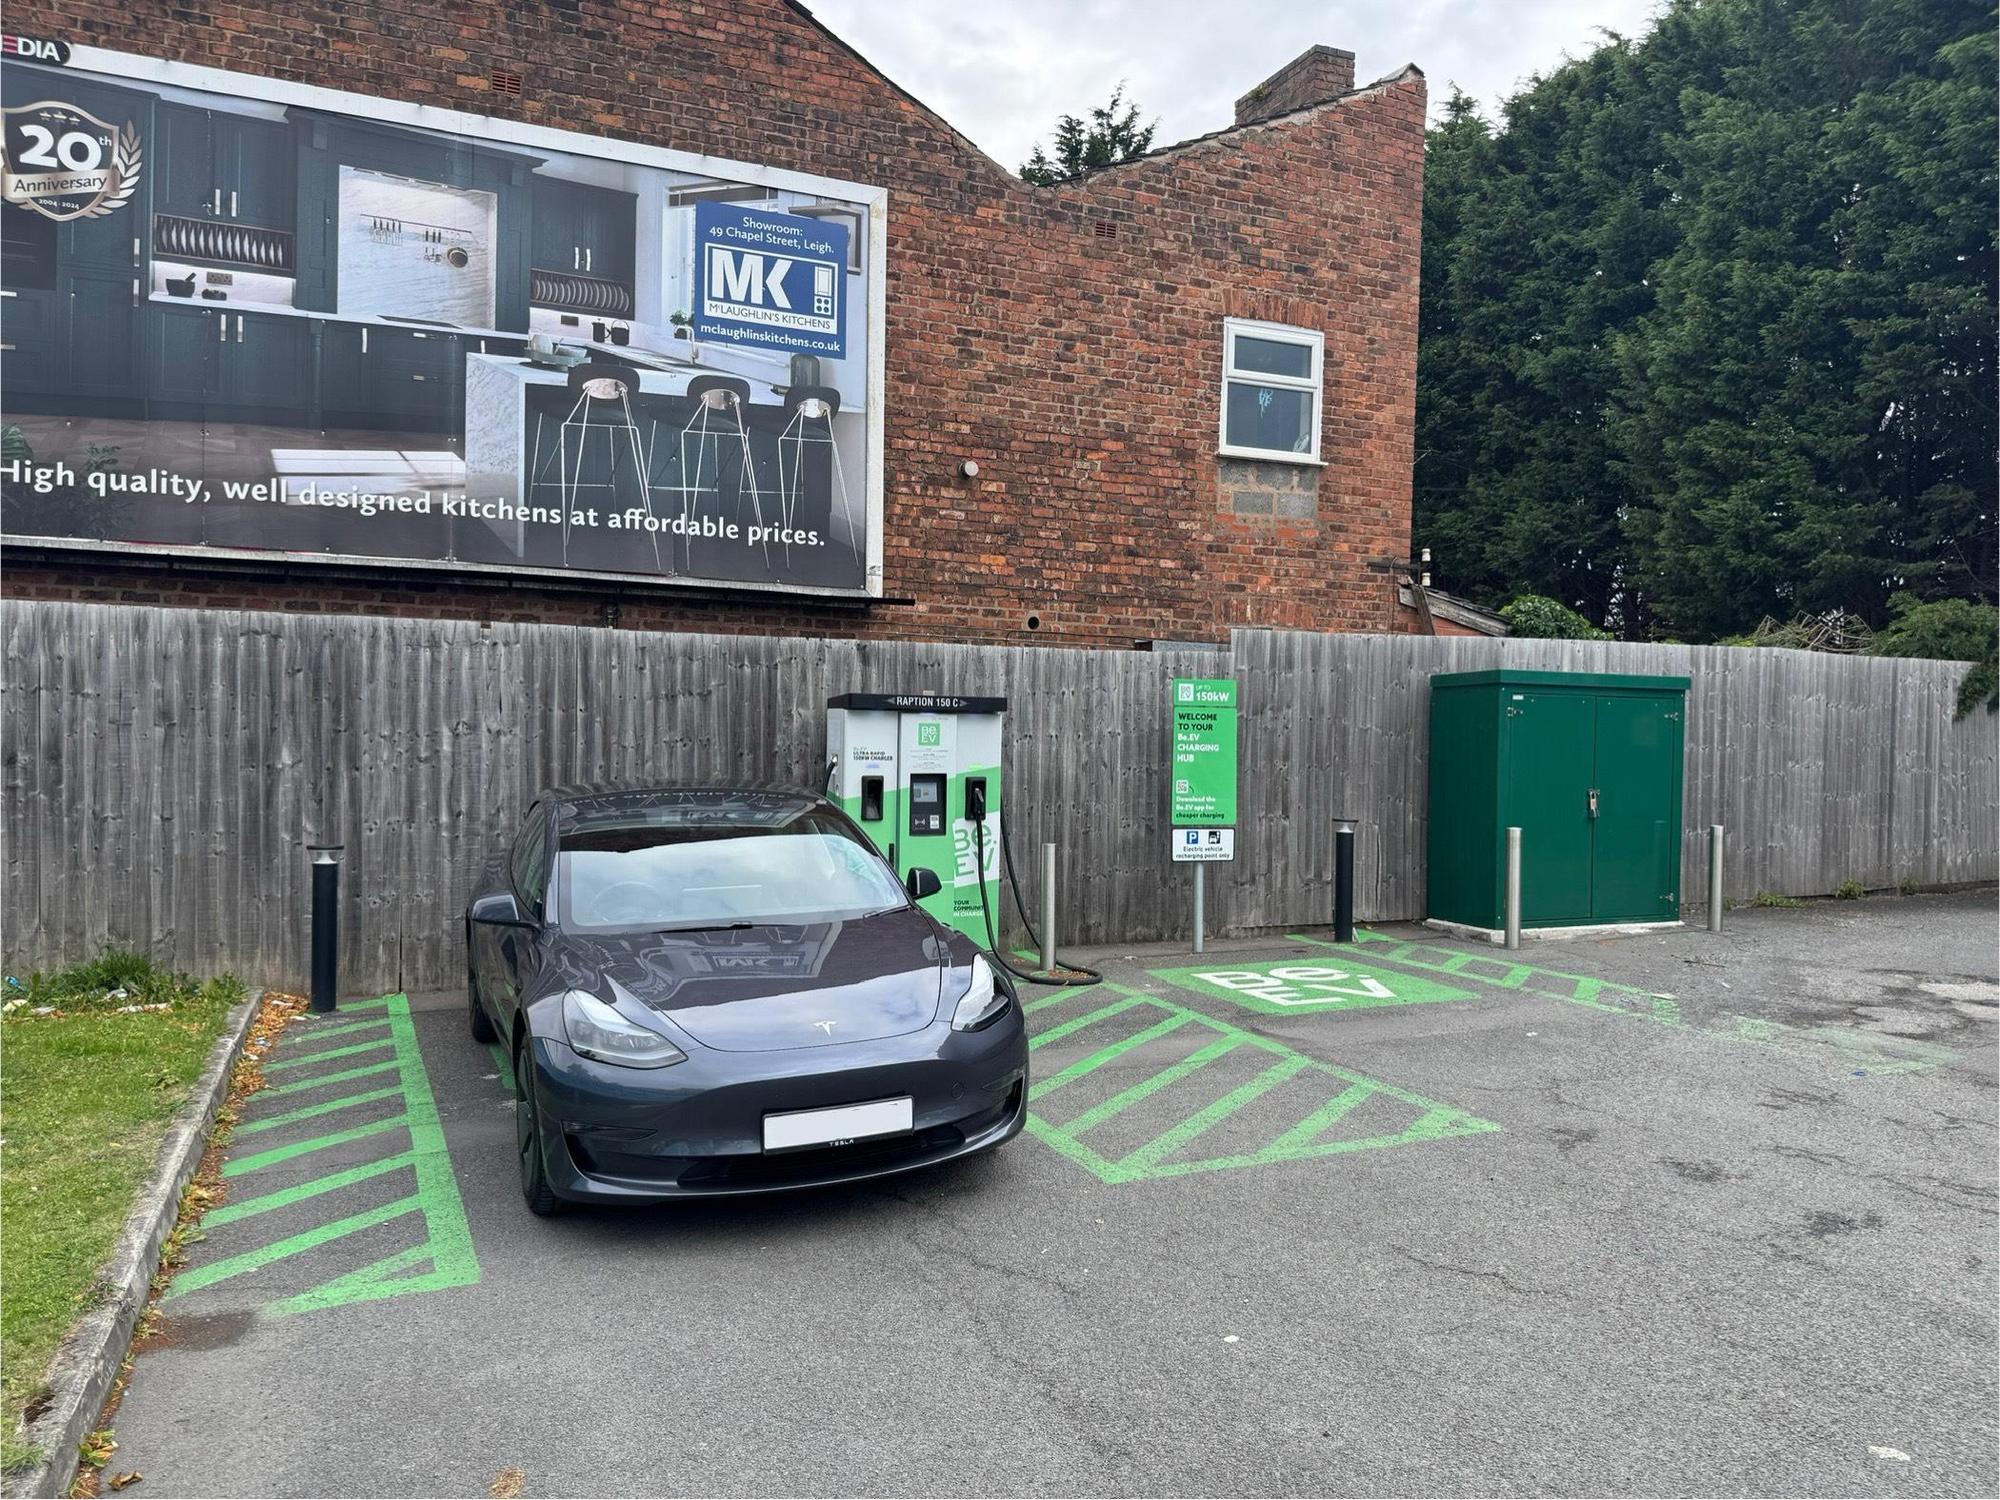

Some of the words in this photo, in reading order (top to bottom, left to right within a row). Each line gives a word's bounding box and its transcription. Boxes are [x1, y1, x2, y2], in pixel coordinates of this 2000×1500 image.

[13, 175, 107, 193] Anniversary
[38, 199, 57, 207] 2004
[62, 202, 80, 210] 2024
[743, 217, 803, 236] Showroom:
[709, 226, 723, 237] 49
[726, 227, 763, 242] Chapel
[766, 234, 801, 249] Street,
[804, 240, 834, 255] Leigh.
[711, 248, 793, 309] MK
[782, 310, 831, 330] KITCHENS
[700, 324, 841, 352] mclaughlinskitchens.co.uk
[88, 469, 212, 503] quality,
[223, 477, 288, 503] well
[299, 479, 432, 516] designed
[442, 495, 562, 524] kitchens
[571, 506, 599, 527] at
[607, 508, 740, 539] affordable
[747, 521, 826, 547] prices.
[896, 696, 933, 707] RAPTION
[936, 698, 951, 708] 150
[952, 698, 958, 708] C
[1196, 691, 1230, 702] 150kW
[1178, 713, 1217, 721] WELCOME
[1178, 723, 1189, 731] TO
[1191, 723, 1213, 731] YOUR
[1177, 733, 1200, 741] Be.EV
[1177, 743, 1219, 752] CHARGING
[1177, 753, 1194, 762] HUB
[1189, 832, 1197, 844] P
[829, 1139, 854, 1147] TESLA
